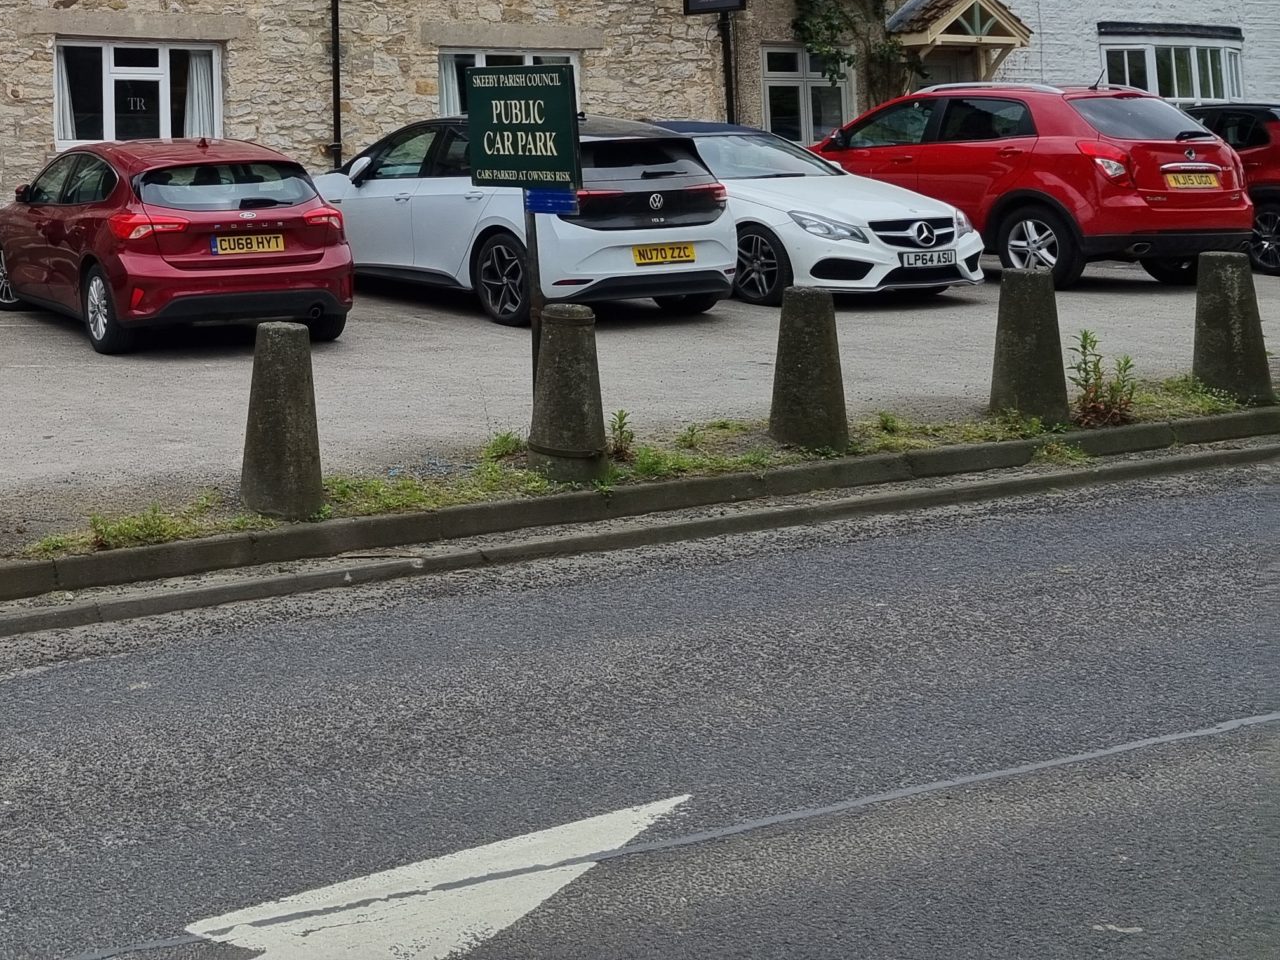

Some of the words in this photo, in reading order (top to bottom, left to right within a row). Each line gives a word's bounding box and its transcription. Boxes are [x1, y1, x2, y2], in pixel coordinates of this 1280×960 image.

[472, 75, 498, 87] SKEEBY
[499, 74, 526, 87] PARISH
[526, 73, 561, 86] COUNCIL
[127, 97, 147, 110] TR
[491, 100, 545, 124] PUBLIC
[483, 131, 514, 155] CAR
[517, 132, 558, 156] PARK
[476, 169, 493, 179] CARS
[493, 170, 518, 180] PARKED
[518, 171, 527, 180] AT
[527, 171, 555, 181] OWNERS
[555, 172, 571, 182] RISK
[1172, 175, 1195, 185] NJ15
[220, 237, 253, 251] CU68
[256, 236, 281, 249] HYT
[638, 247, 667, 261] NU70
[668, 246, 690, 259] ZZC
[907, 253, 934, 266] LP64
[936, 251, 953, 264] ASU
